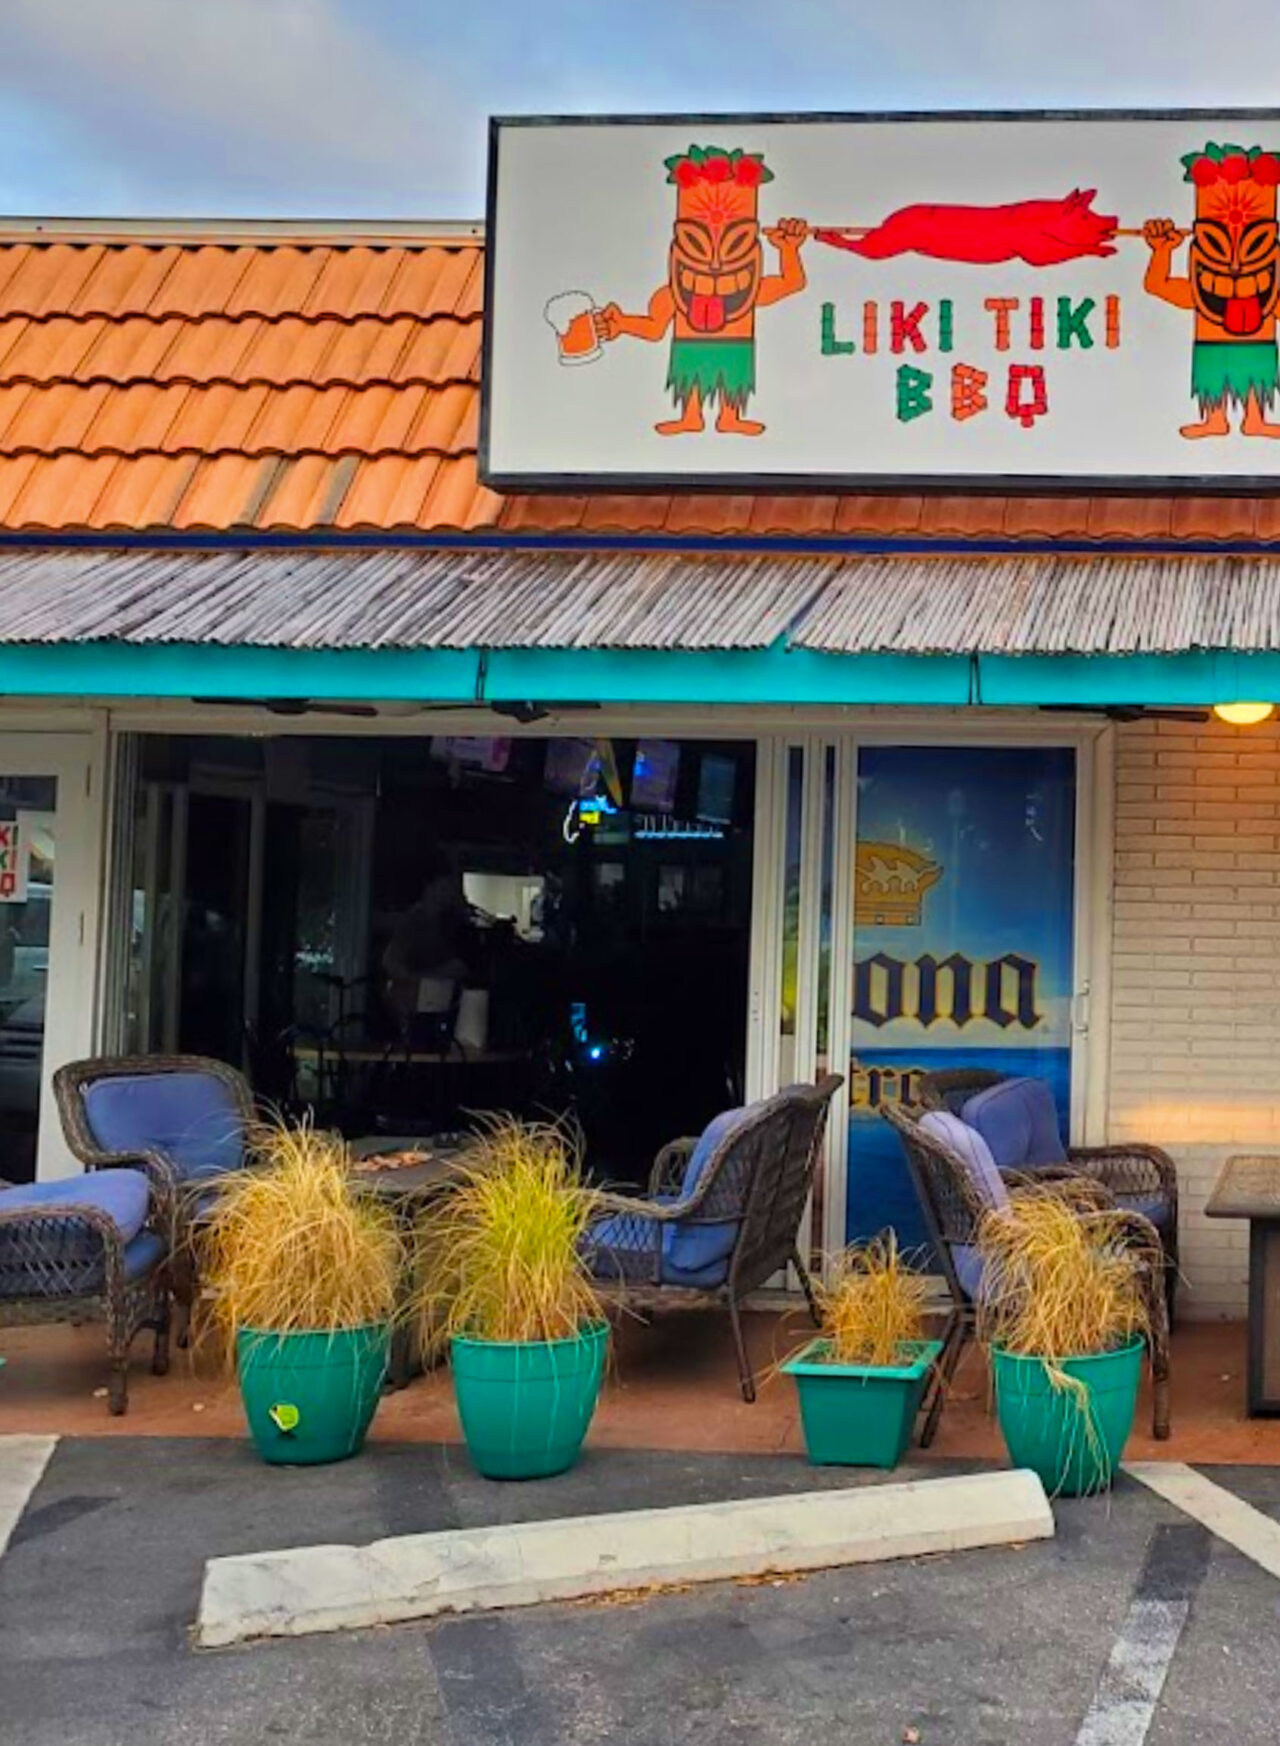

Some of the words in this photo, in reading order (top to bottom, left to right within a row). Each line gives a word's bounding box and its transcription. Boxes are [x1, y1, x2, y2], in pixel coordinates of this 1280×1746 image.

[821, 299, 953, 355] LIKI
[984, 294, 1120, 351] TIKI
[896, 363, 1048, 428] BBQ
